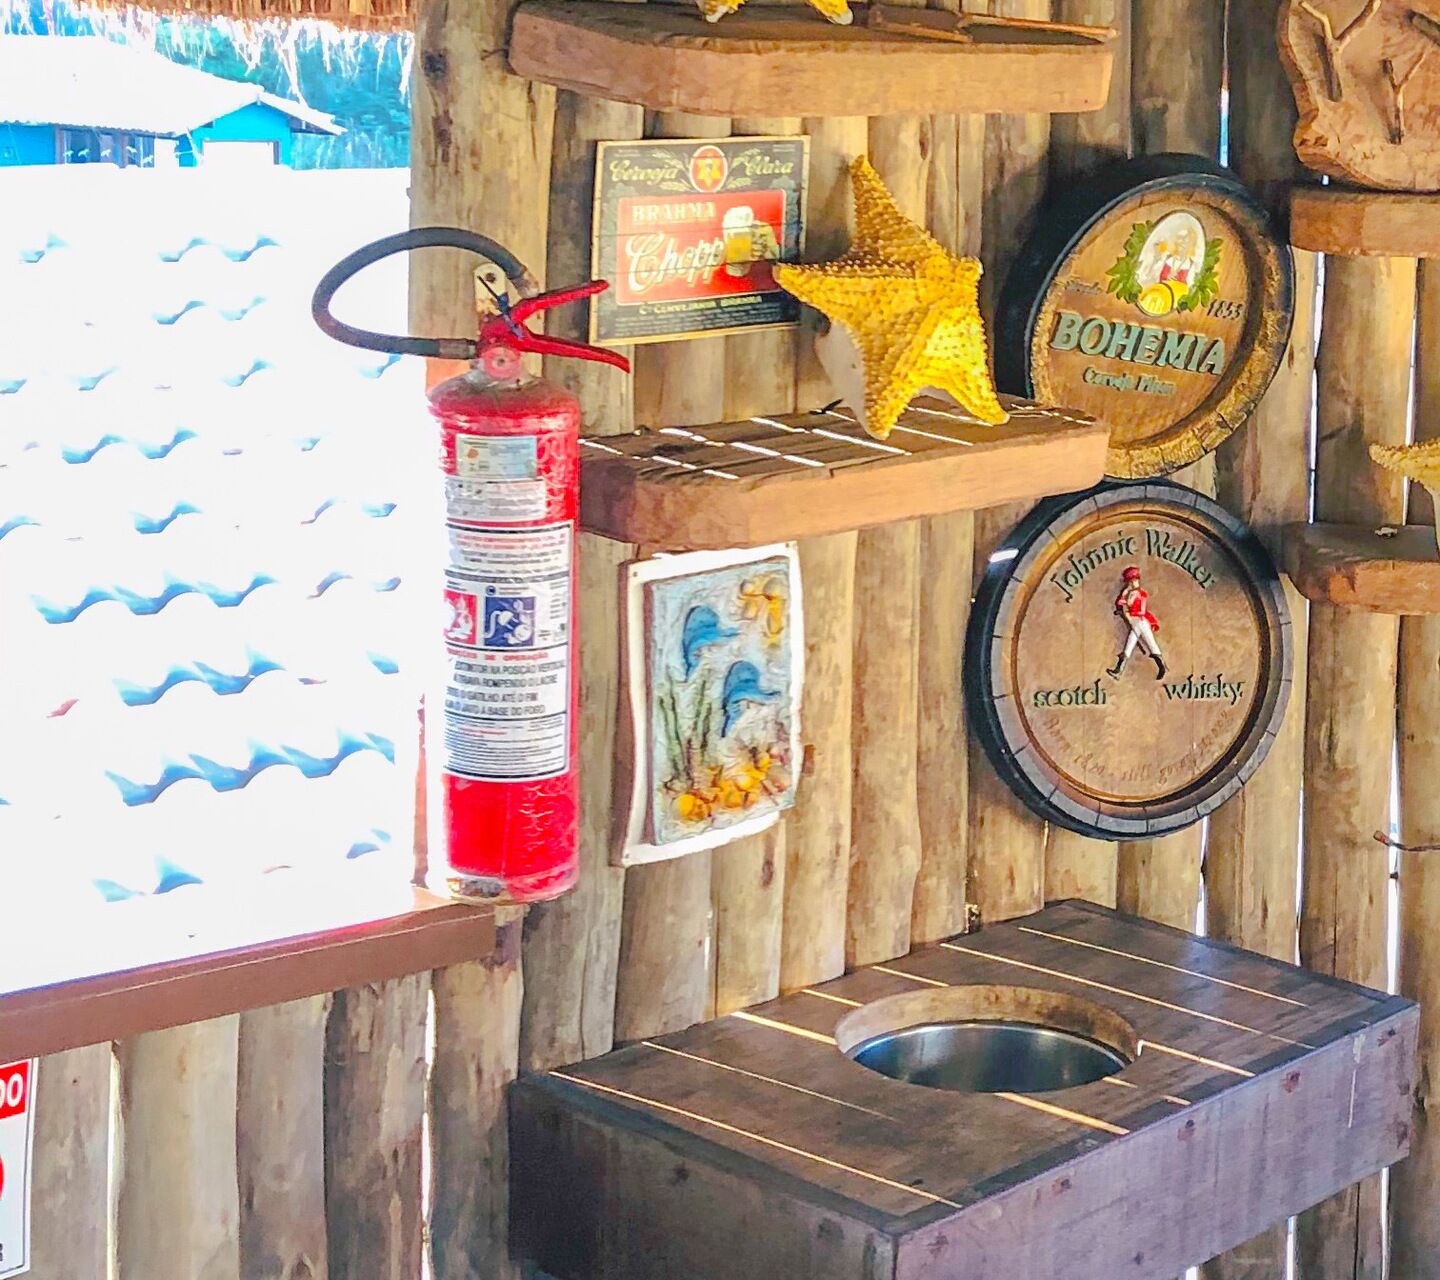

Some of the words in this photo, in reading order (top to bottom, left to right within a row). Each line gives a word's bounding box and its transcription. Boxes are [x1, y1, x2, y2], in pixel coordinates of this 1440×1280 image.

[609, 159, 680, 185] Cerveja
[744, 155, 794, 177] Clara
[631, 201, 715, 224] BRAHMA
[625, 231, 726, 291] Chopp
[1050, 310, 1226, 375] BOHEMIA
[1050, 529, 1138, 603] Johnnie
[1145, 527, 1217, 589] Walker
[1033, 678, 1107, 708] scotch
